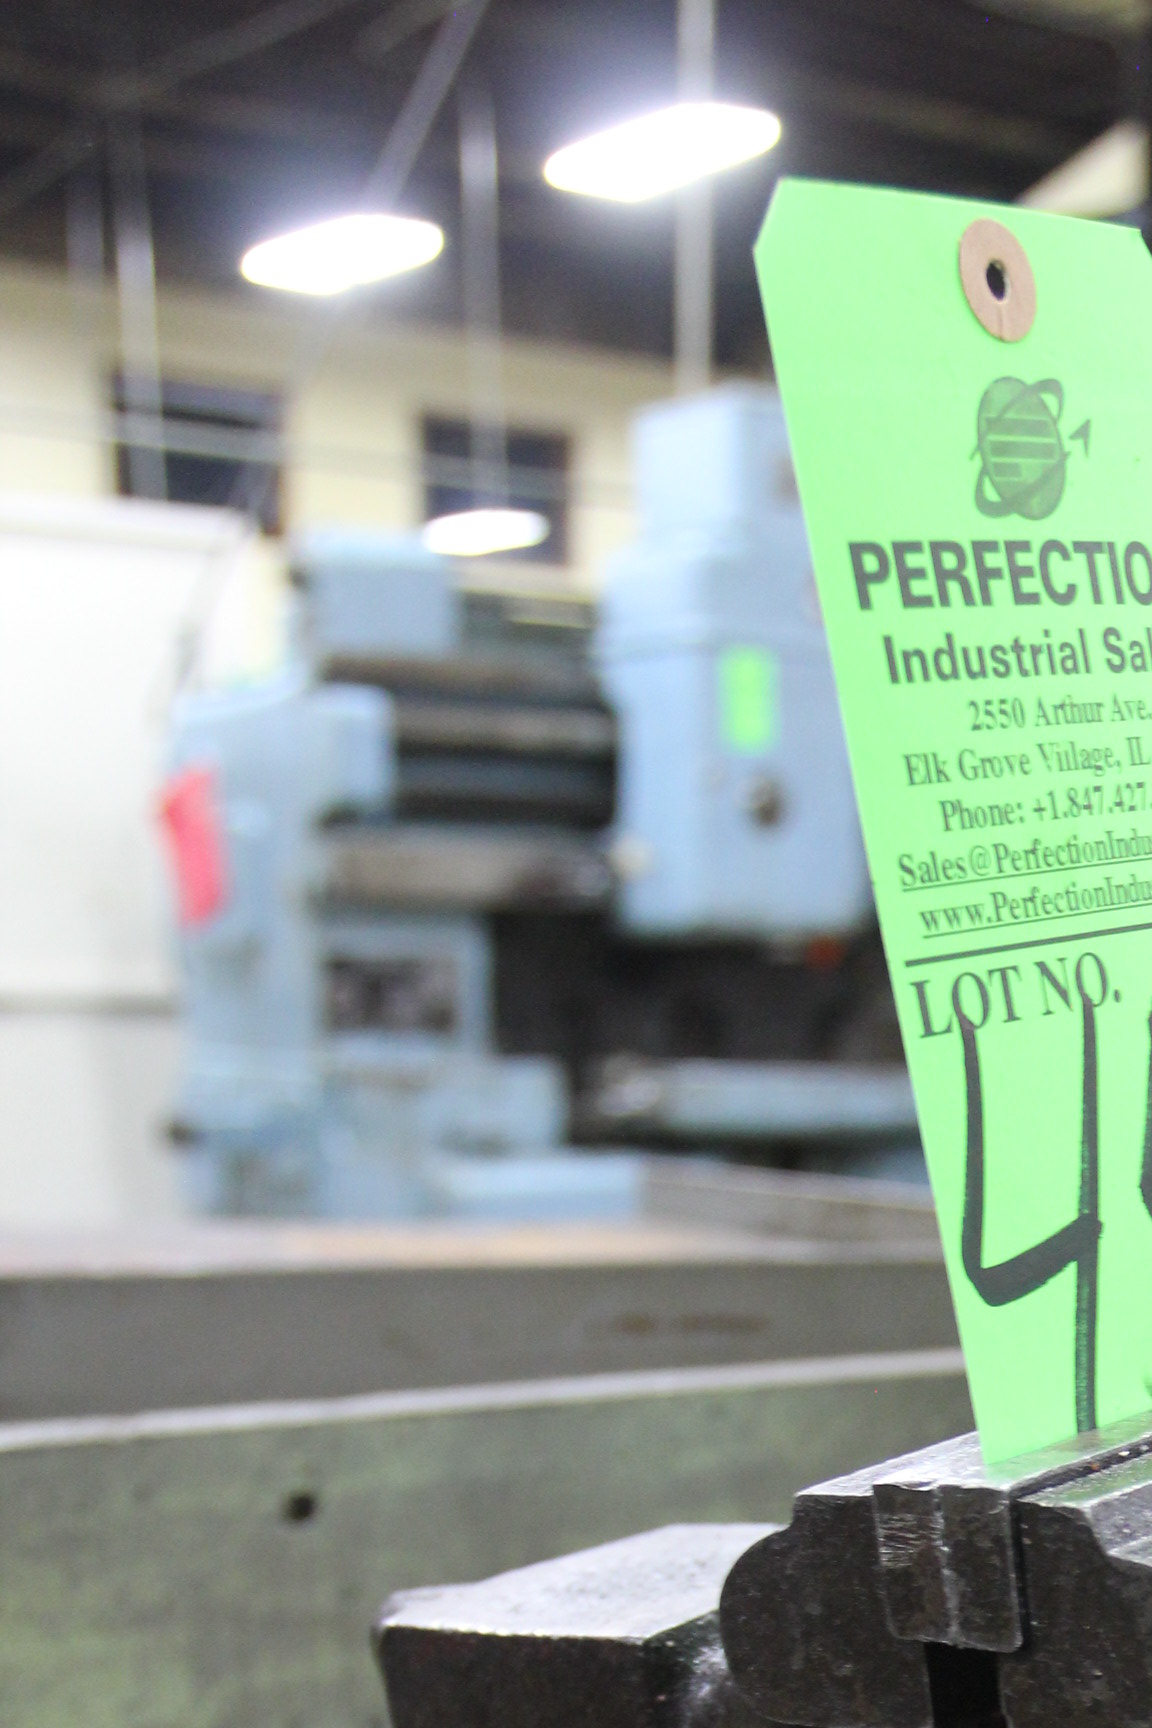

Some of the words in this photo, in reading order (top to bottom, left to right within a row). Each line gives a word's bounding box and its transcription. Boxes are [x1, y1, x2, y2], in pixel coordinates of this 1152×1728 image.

[882, 628, 1092, 685] Industrial
[968, 696, 1026, 732] 2550
[1033, 693, 1105, 728] Arthur
[902, 751, 953, 787] Elk
[957, 748, 1032, 782] Grove
[1035, 740, 1123, 777] Village,
[1125, 736, 1151, 767] IL
[939, 797, 1026, 832] Phone:
[909, 963, 1022, 1039] LOT
[1038, 951, 1123, 1018] NO.
